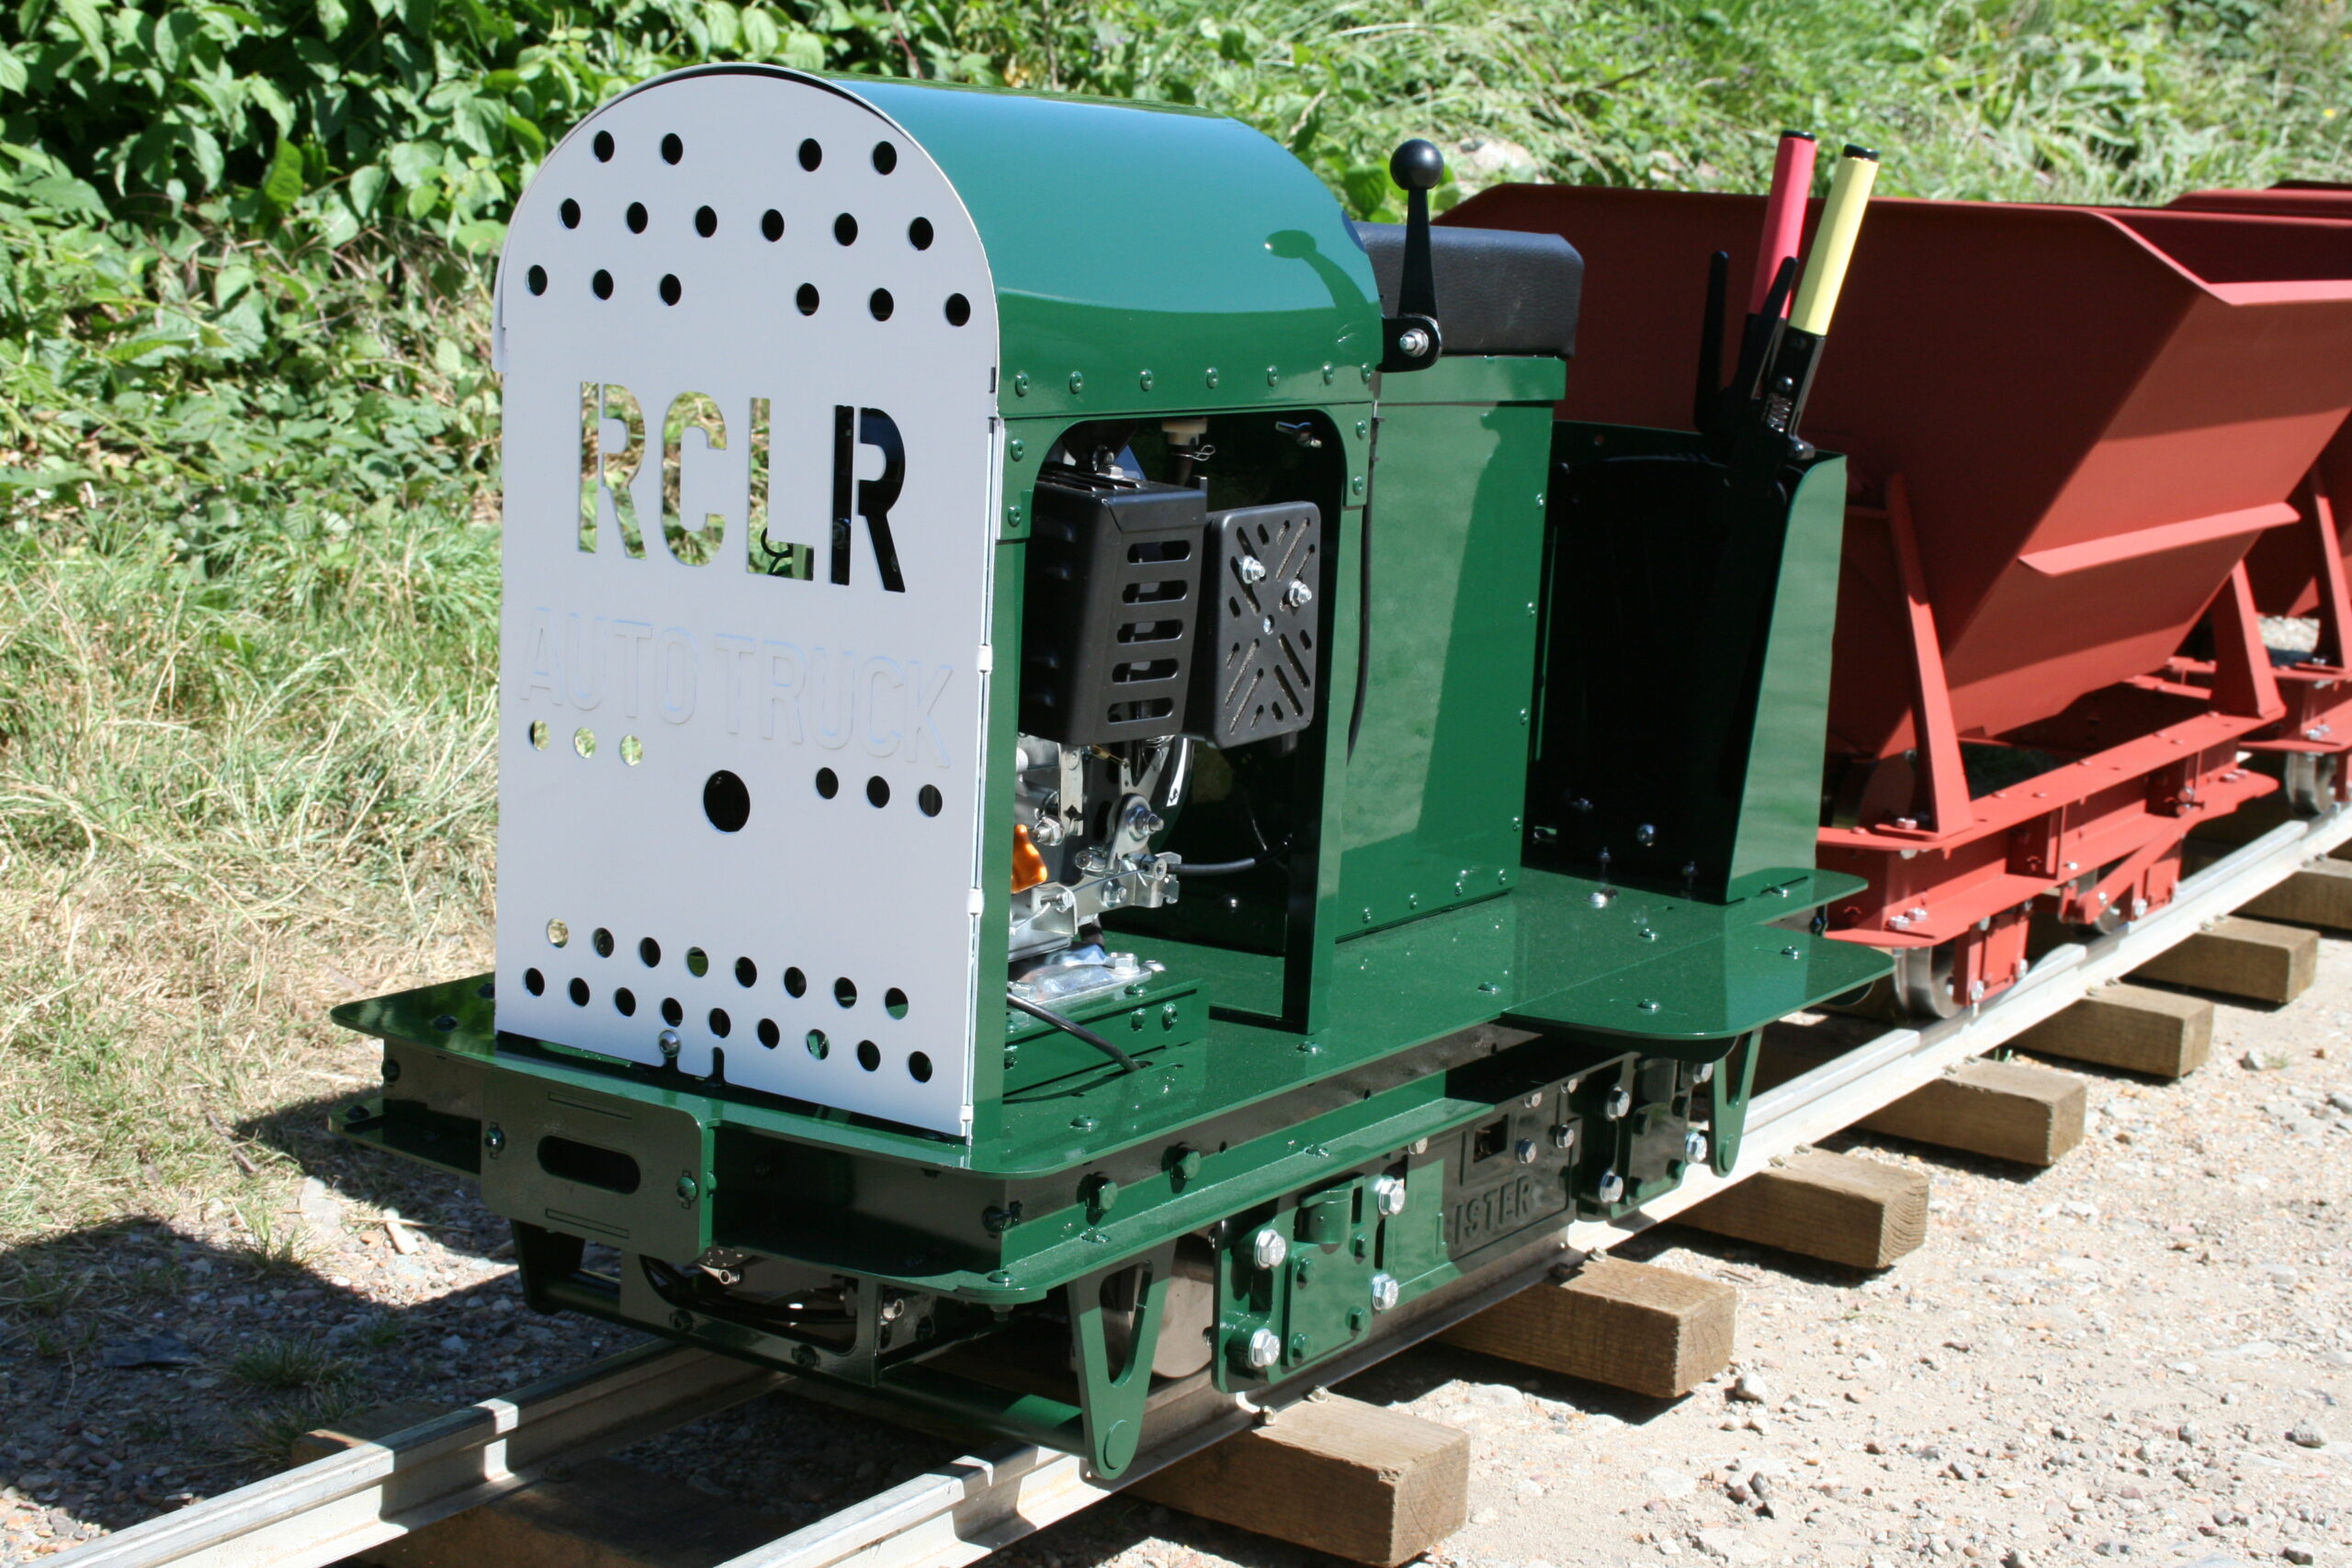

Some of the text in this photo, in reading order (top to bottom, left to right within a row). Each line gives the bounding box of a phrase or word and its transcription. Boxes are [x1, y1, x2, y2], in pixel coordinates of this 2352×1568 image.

[577, 380, 907, 593] RCLR
[520, 606, 954, 769] AUTO TRUCK
